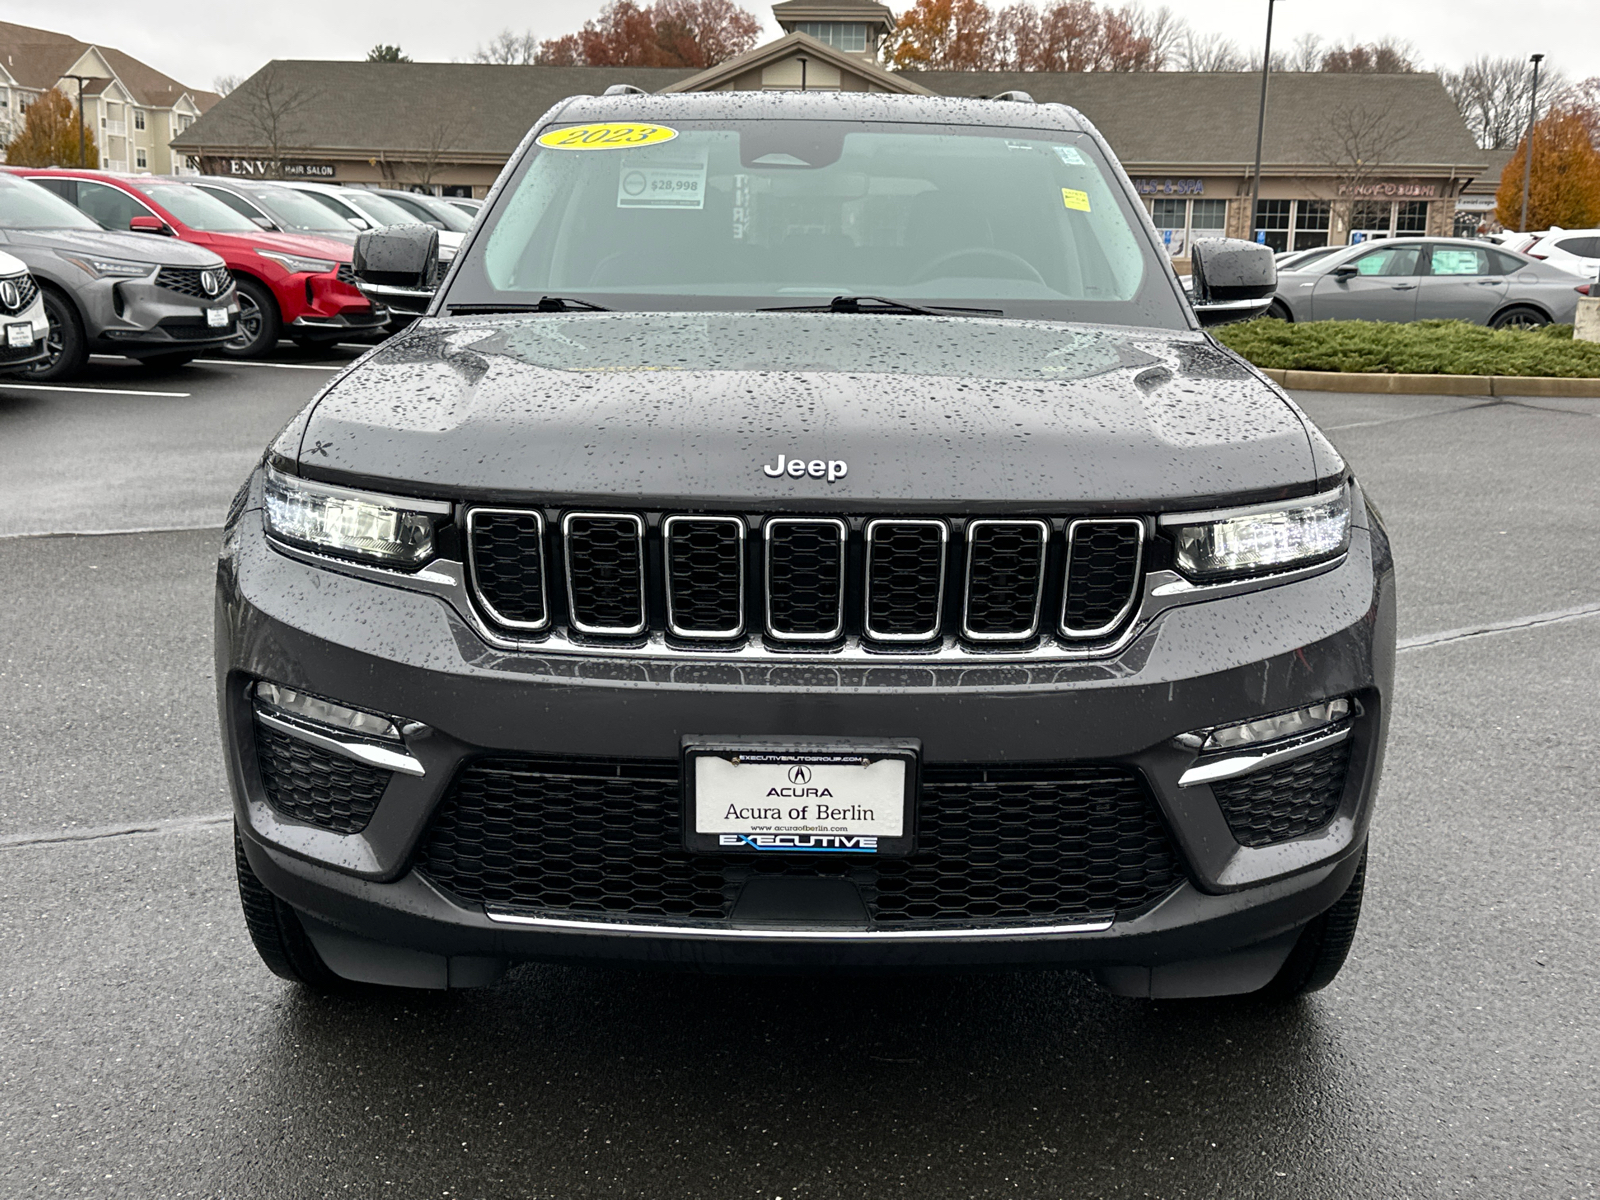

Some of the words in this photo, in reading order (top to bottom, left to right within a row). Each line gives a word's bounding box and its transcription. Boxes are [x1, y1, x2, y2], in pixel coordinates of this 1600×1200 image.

[557, 128, 658, 145] 2023
[306, 166, 333, 175] SALON
[651, 180, 698, 192] $28,998
[1163, 179, 1174, 194] &
[1178, 179, 1204, 195] SPA
[763, 454, 848, 483] Jeep
[766, 787, 833, 798] ACURA
[724, 804, 782, 820] Acura
[788, 805, 808, 820] of
[816, 805, 875, 821] Berlin
[750, 824, 848, 832] www.acuraofberlin.com
[719, 834, 878, 850] EXECUTIVE
